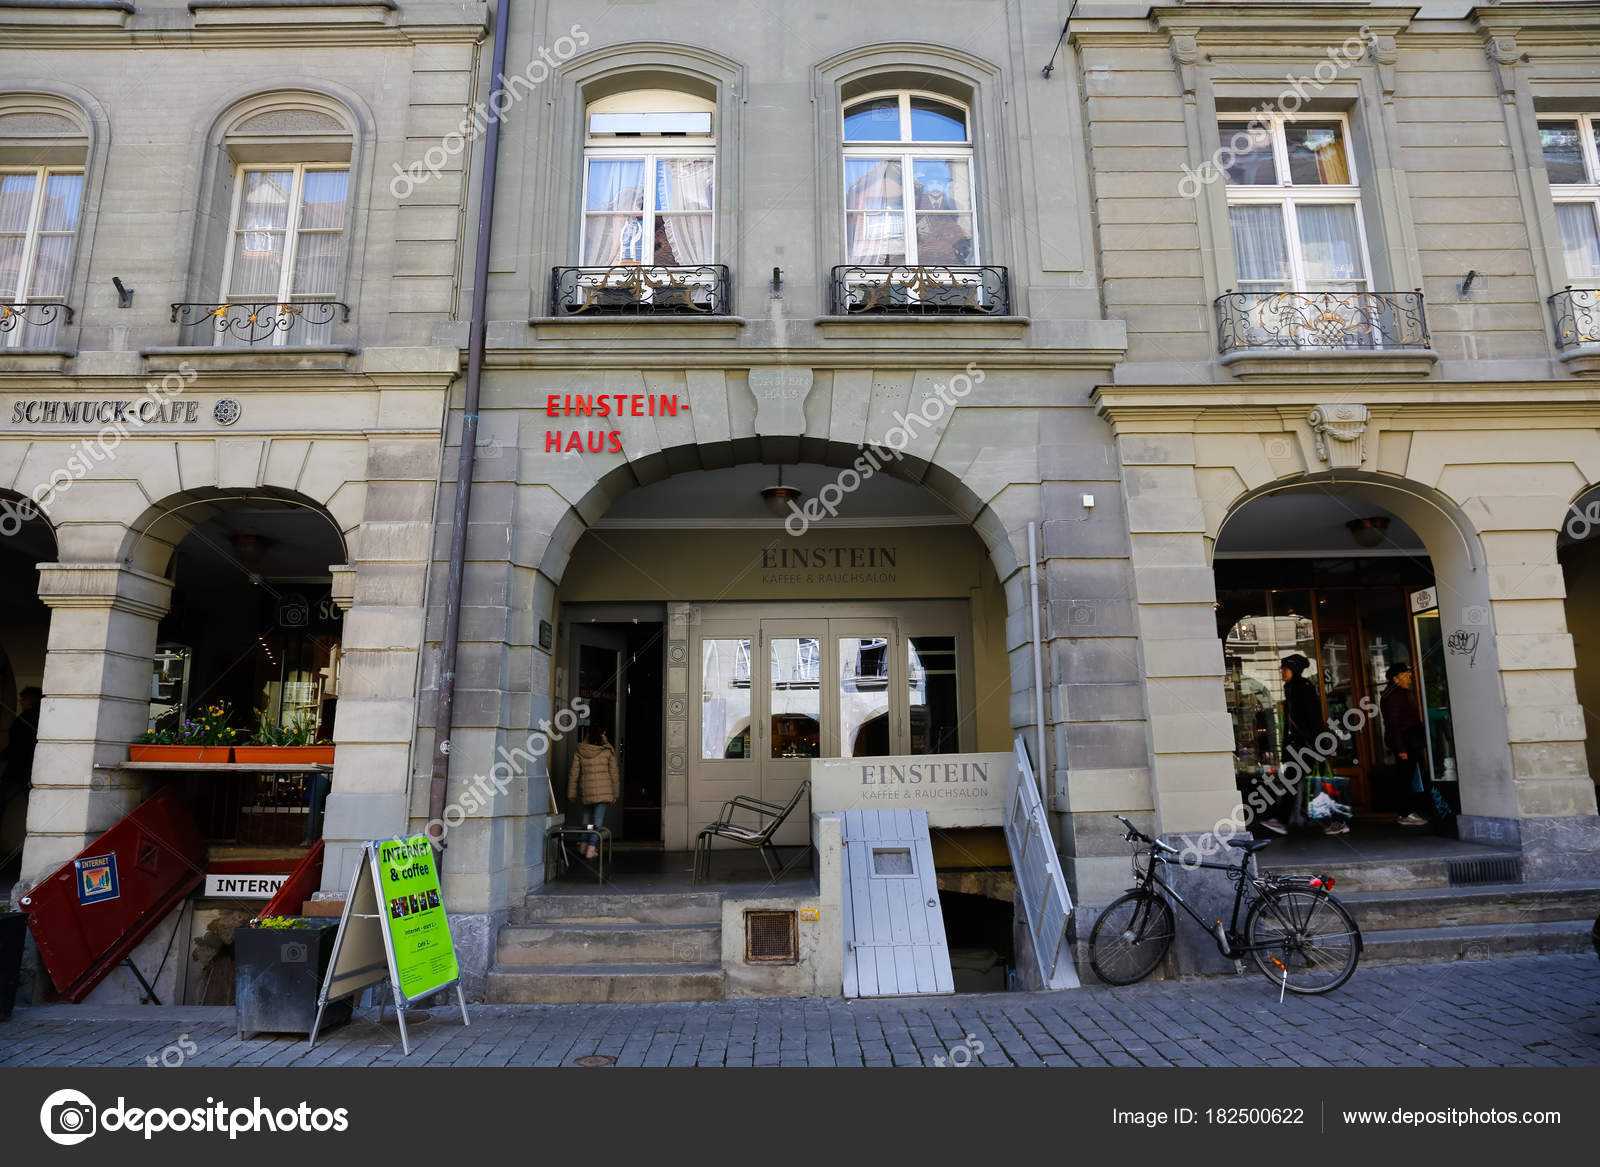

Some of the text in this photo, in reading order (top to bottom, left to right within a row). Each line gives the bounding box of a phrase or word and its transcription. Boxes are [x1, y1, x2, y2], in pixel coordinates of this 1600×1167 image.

[11, 401, 199, 424] SCHMUCK-CAFE
[546, 394, 689, 417] EINSTEIN-
[545, 430, 622, 453] HAUS
[761, 547, 896, 568] EINSTEIN
[762, 572, 896, 585] KAFFEE & RAUCHSALON
[861, 762, 989, 784] EINSTEIN
[862, 787, 988, 800] KAFFEE & RAUCHSALON
[382, 842, 428, 863] INTERNET
[390, 863, 429, 882] & coffee
